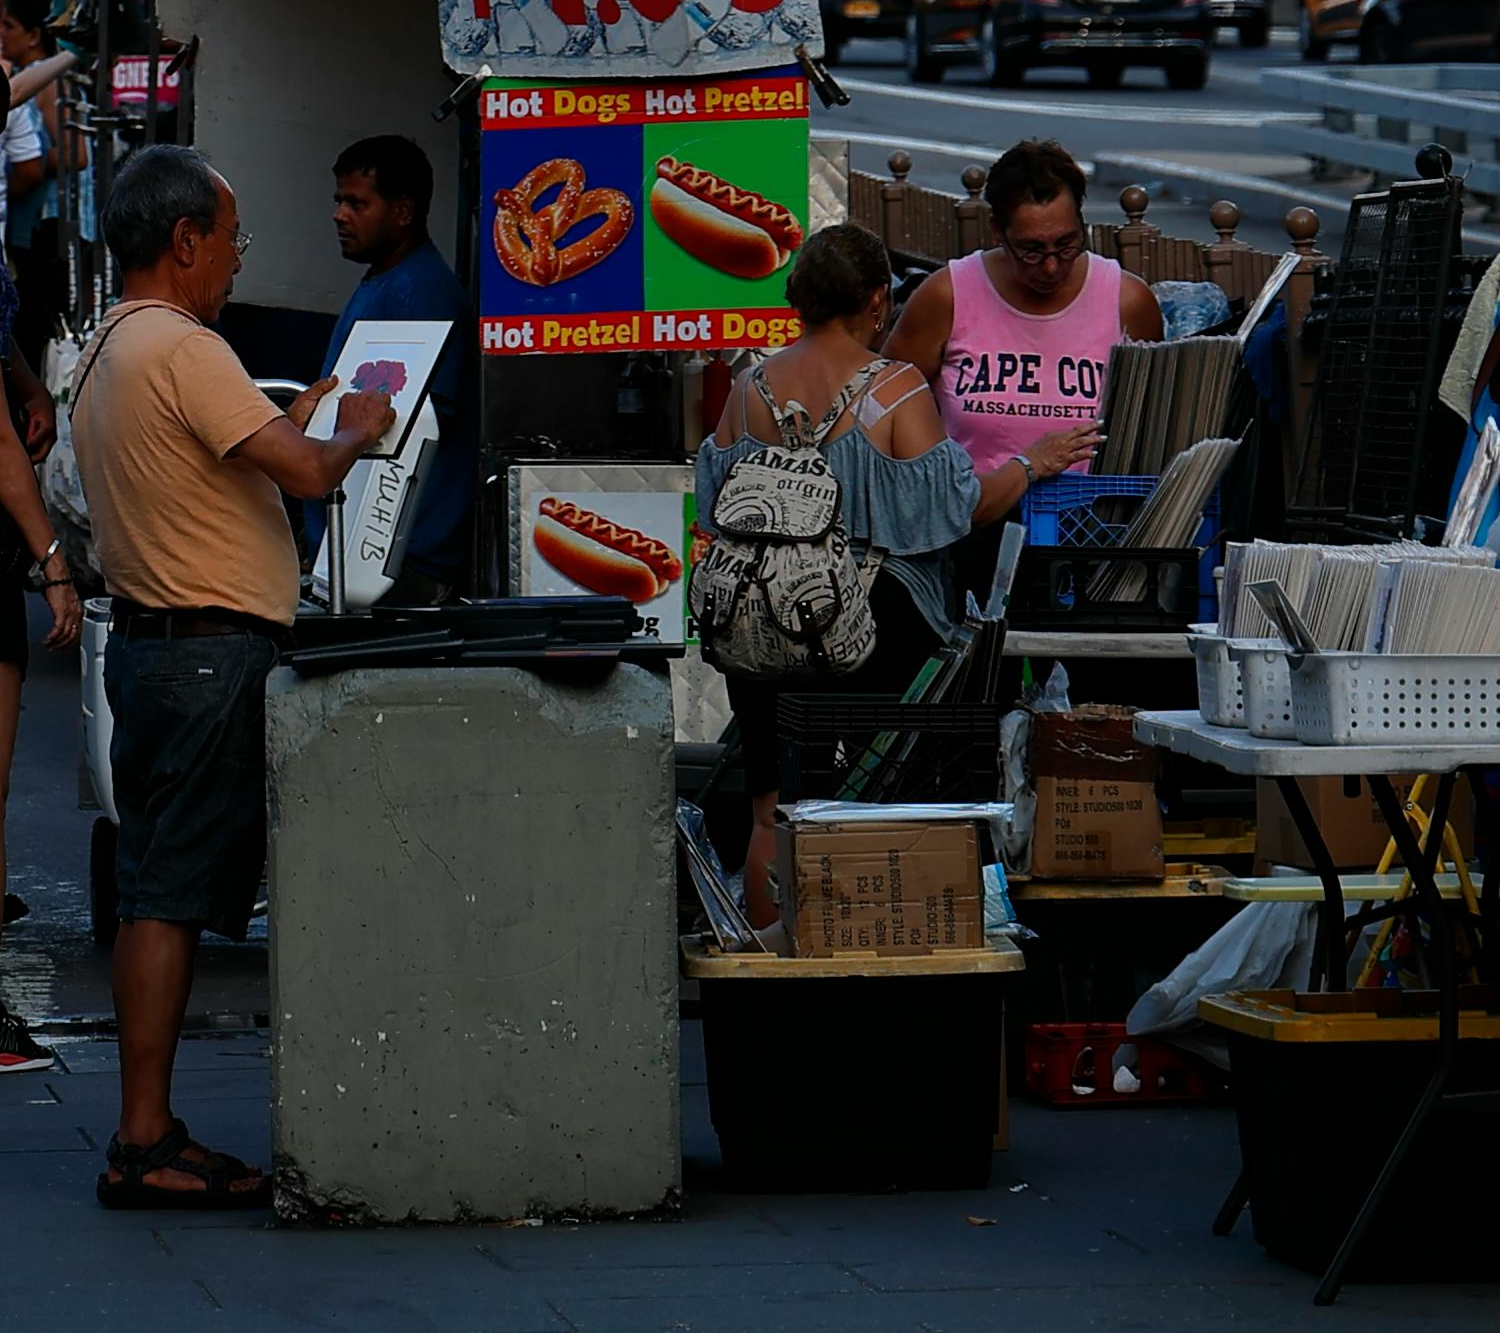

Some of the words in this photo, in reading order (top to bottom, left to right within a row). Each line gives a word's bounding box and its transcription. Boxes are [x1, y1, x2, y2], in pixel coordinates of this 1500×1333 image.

[486, 92, 543, 119] Hot
[554, 90, 631, 123] Dogs
[645, 89, 697, 116] Hot
[705, 82, 804, 113] Pretzel
[483, 322, 534, 349] Hot
[543, 316, 640, 348] Pretzel
[653, 314, 712, 342] Hot
[722, 312, 801, 348] Dogs
[955, 353, 1042, 397] CAPE
[962, 399, 1097, 419] MASSACHUSETT
[1103, 785, 1119, 797] PCS
[1055, 834, 1083, 846] STUDIO
[857, 875, 869, 893] PCS
[872, 875, 884, 893] PCS
[927, 912, 939, 945] STUDIO
